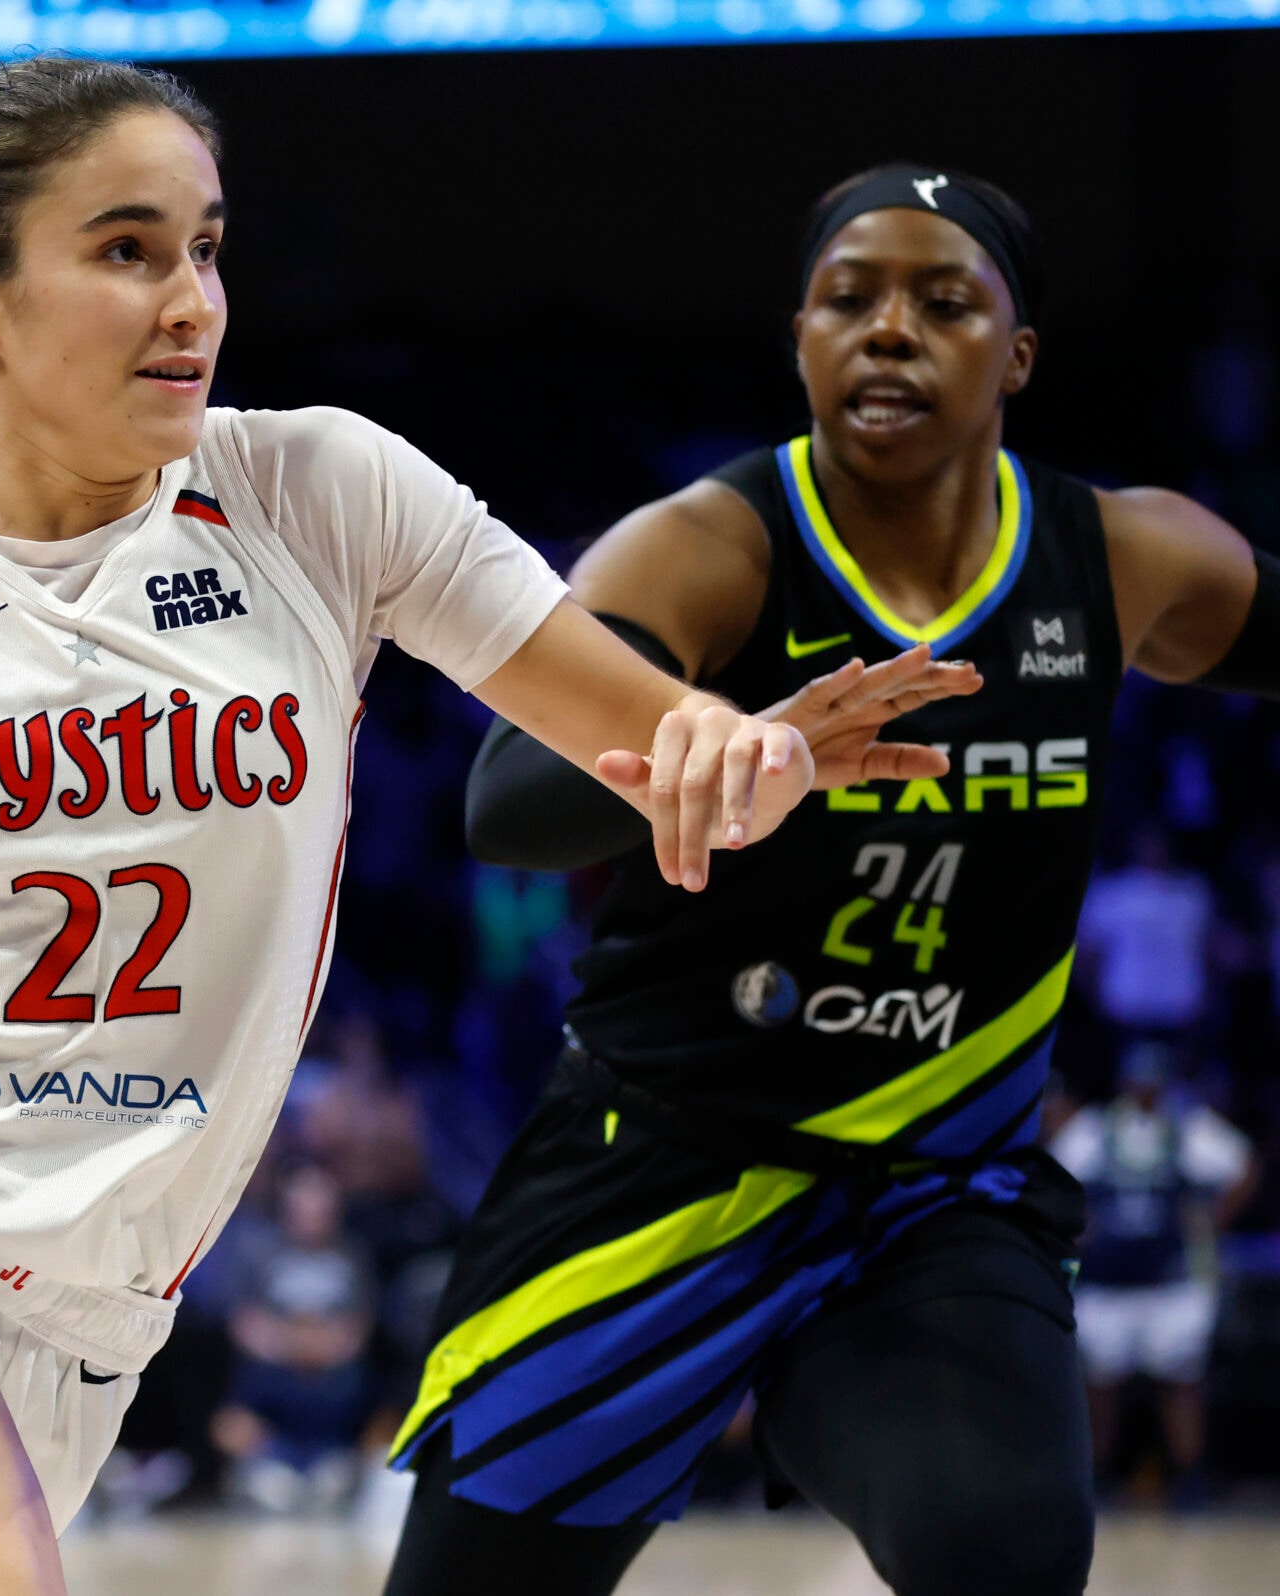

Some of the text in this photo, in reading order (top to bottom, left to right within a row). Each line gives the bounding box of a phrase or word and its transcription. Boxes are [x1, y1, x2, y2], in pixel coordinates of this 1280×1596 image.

[145, 567, 223, 602] CAR
[152, 589, 249, 631] max
[1019, 650, 1086, 678] Albert
[822, 843, 964, 975] 24
[2, 862, 192, 1024] 22
[9, 1071, 208, 1114] VANDA
[19, 1108, 174, 1125] PHARMACEUTICALS
